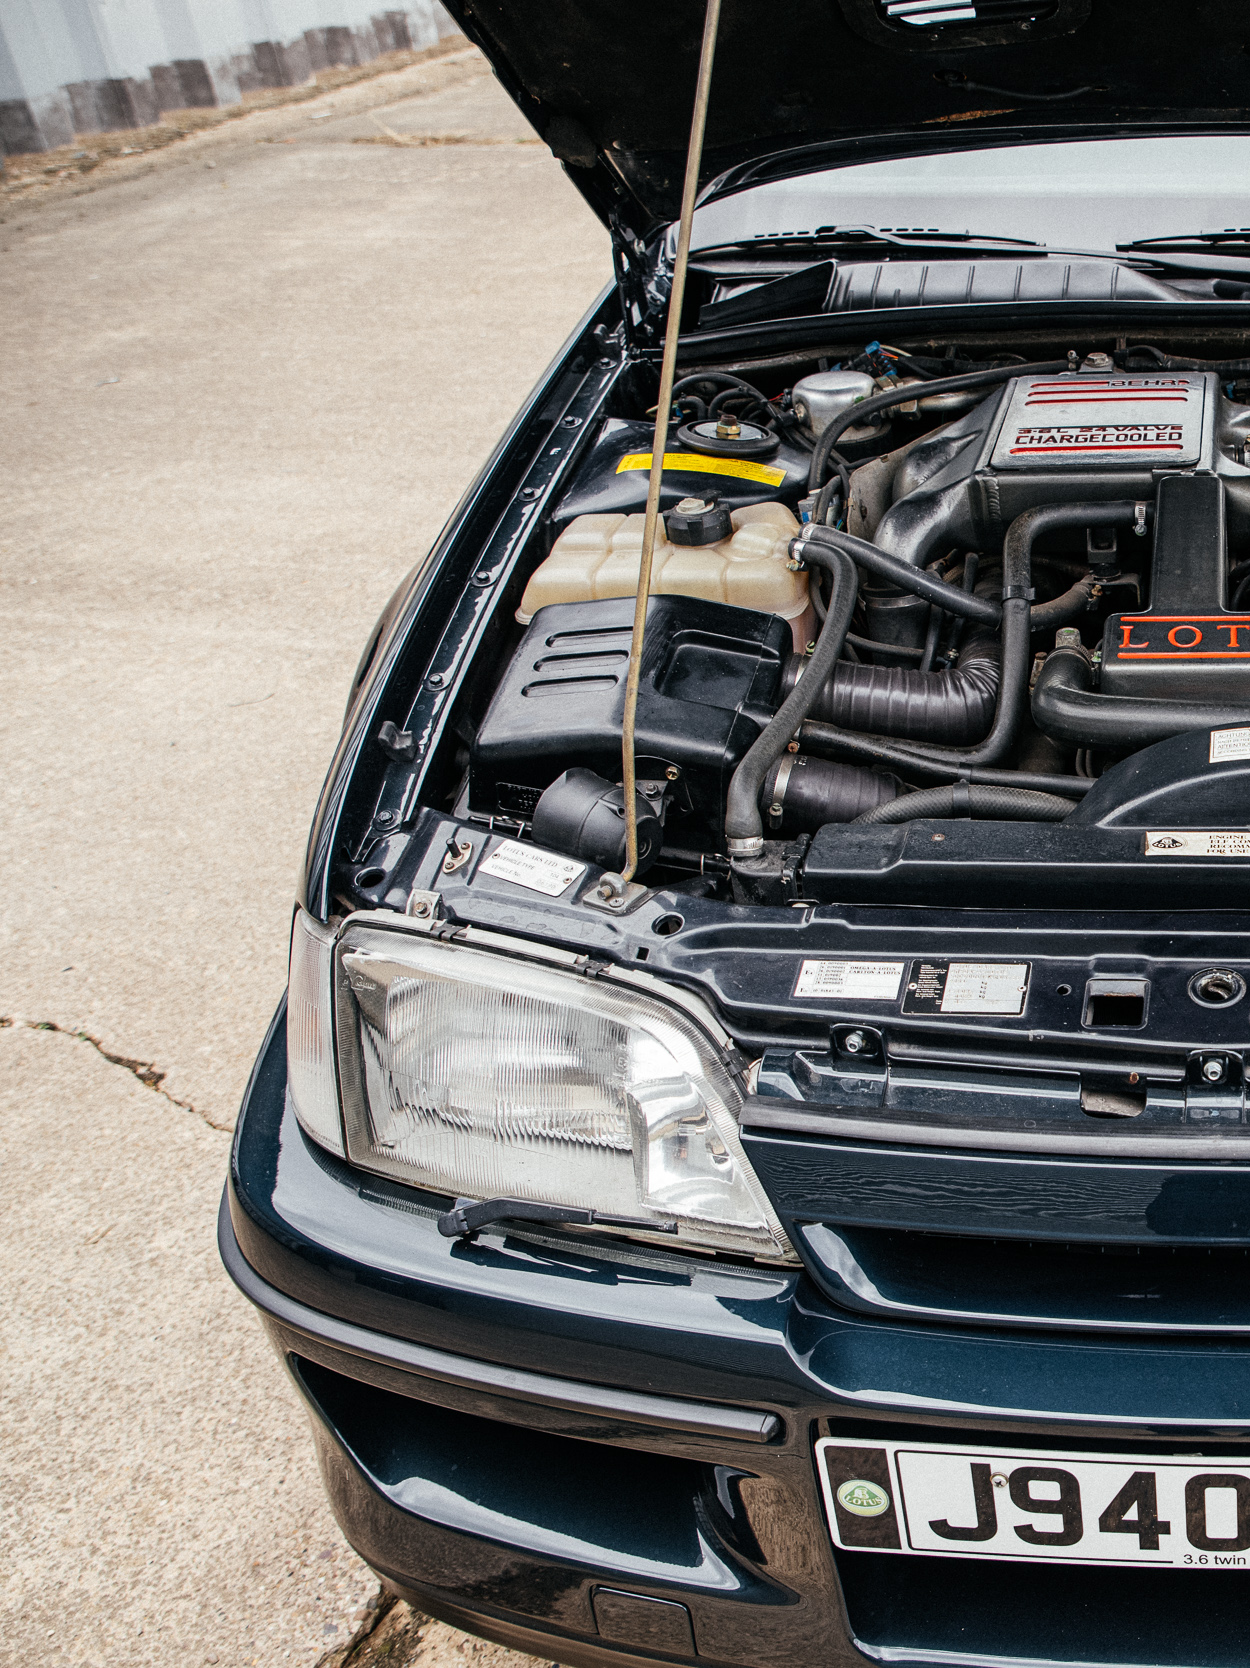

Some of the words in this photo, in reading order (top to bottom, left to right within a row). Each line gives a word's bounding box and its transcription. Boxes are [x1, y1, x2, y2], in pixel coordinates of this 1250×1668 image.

[1014, 431, 1184, 445] CHARGECOOLED
[845, 1495, 883, 1507] LOTUS
[1183, 1553, 1209, 1565] 3.6
[1213, 1555, 1247, 1565] twin
